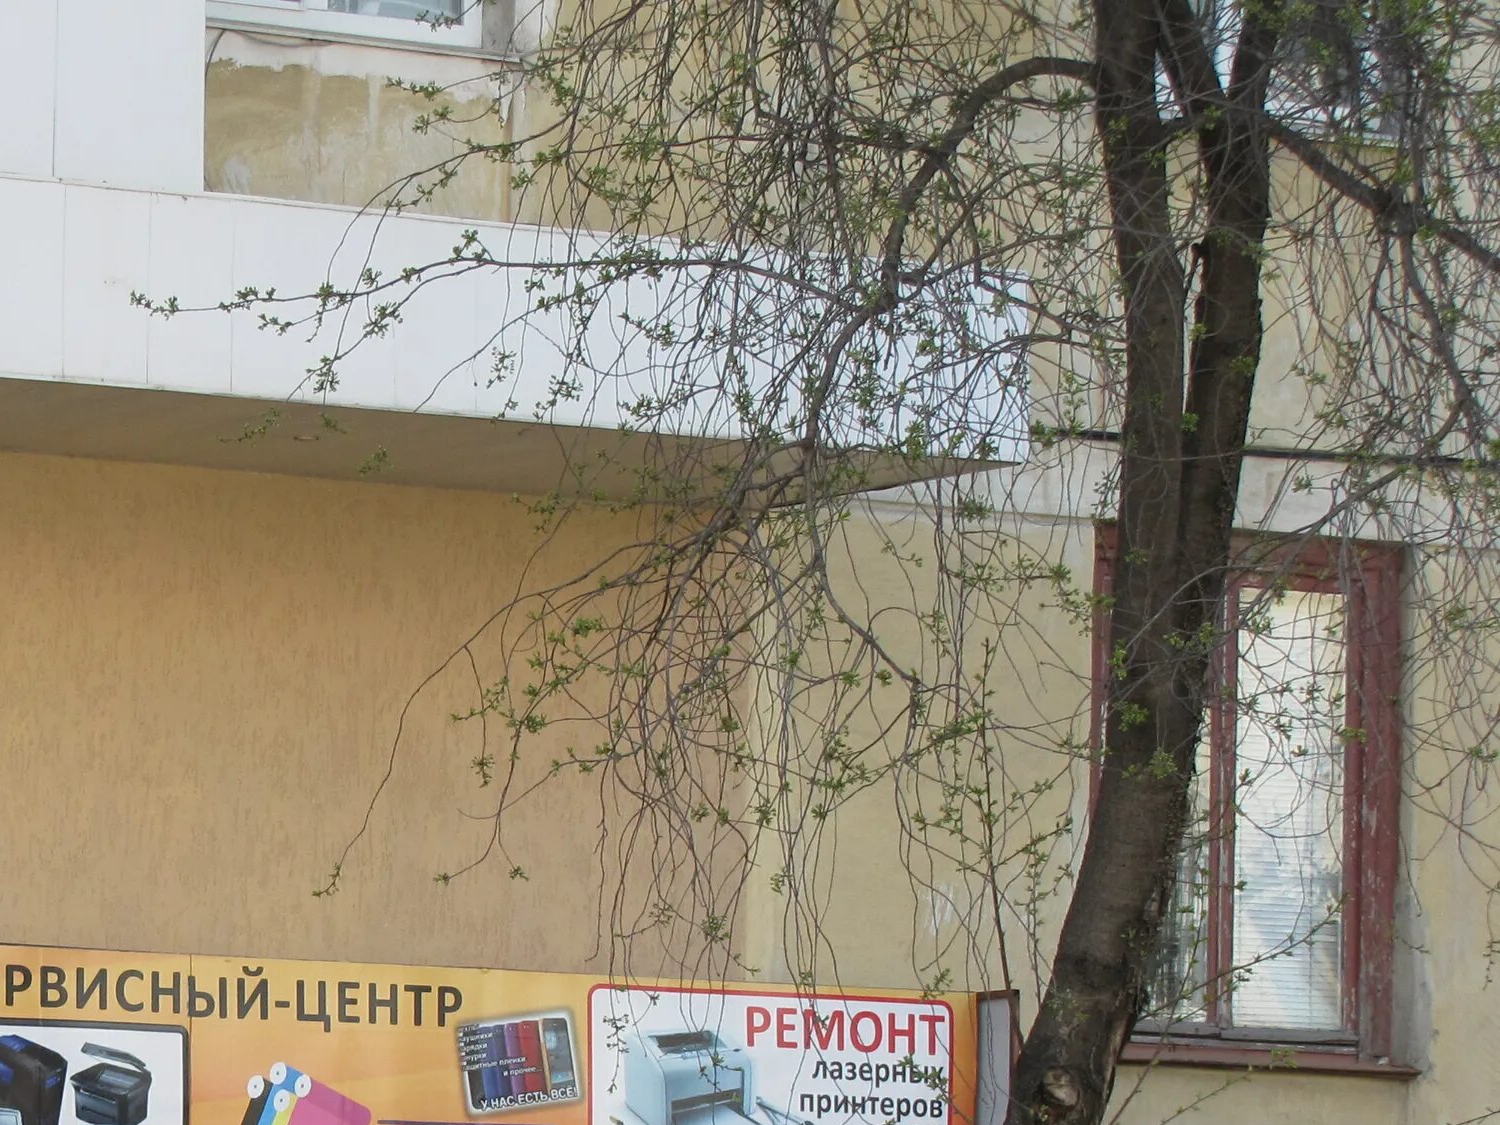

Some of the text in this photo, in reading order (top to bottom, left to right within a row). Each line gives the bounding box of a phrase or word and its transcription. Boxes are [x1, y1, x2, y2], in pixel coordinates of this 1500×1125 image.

[746, 1006, 946, 1056] РЕМОНТ
[812, 1060, 944, 1088] лазерных
[491, 1096, 515, 1108] НАС
[518, 1091, 547, 1105] ЕСТЬ
[800, 1093, 943, 1122] принтеров
